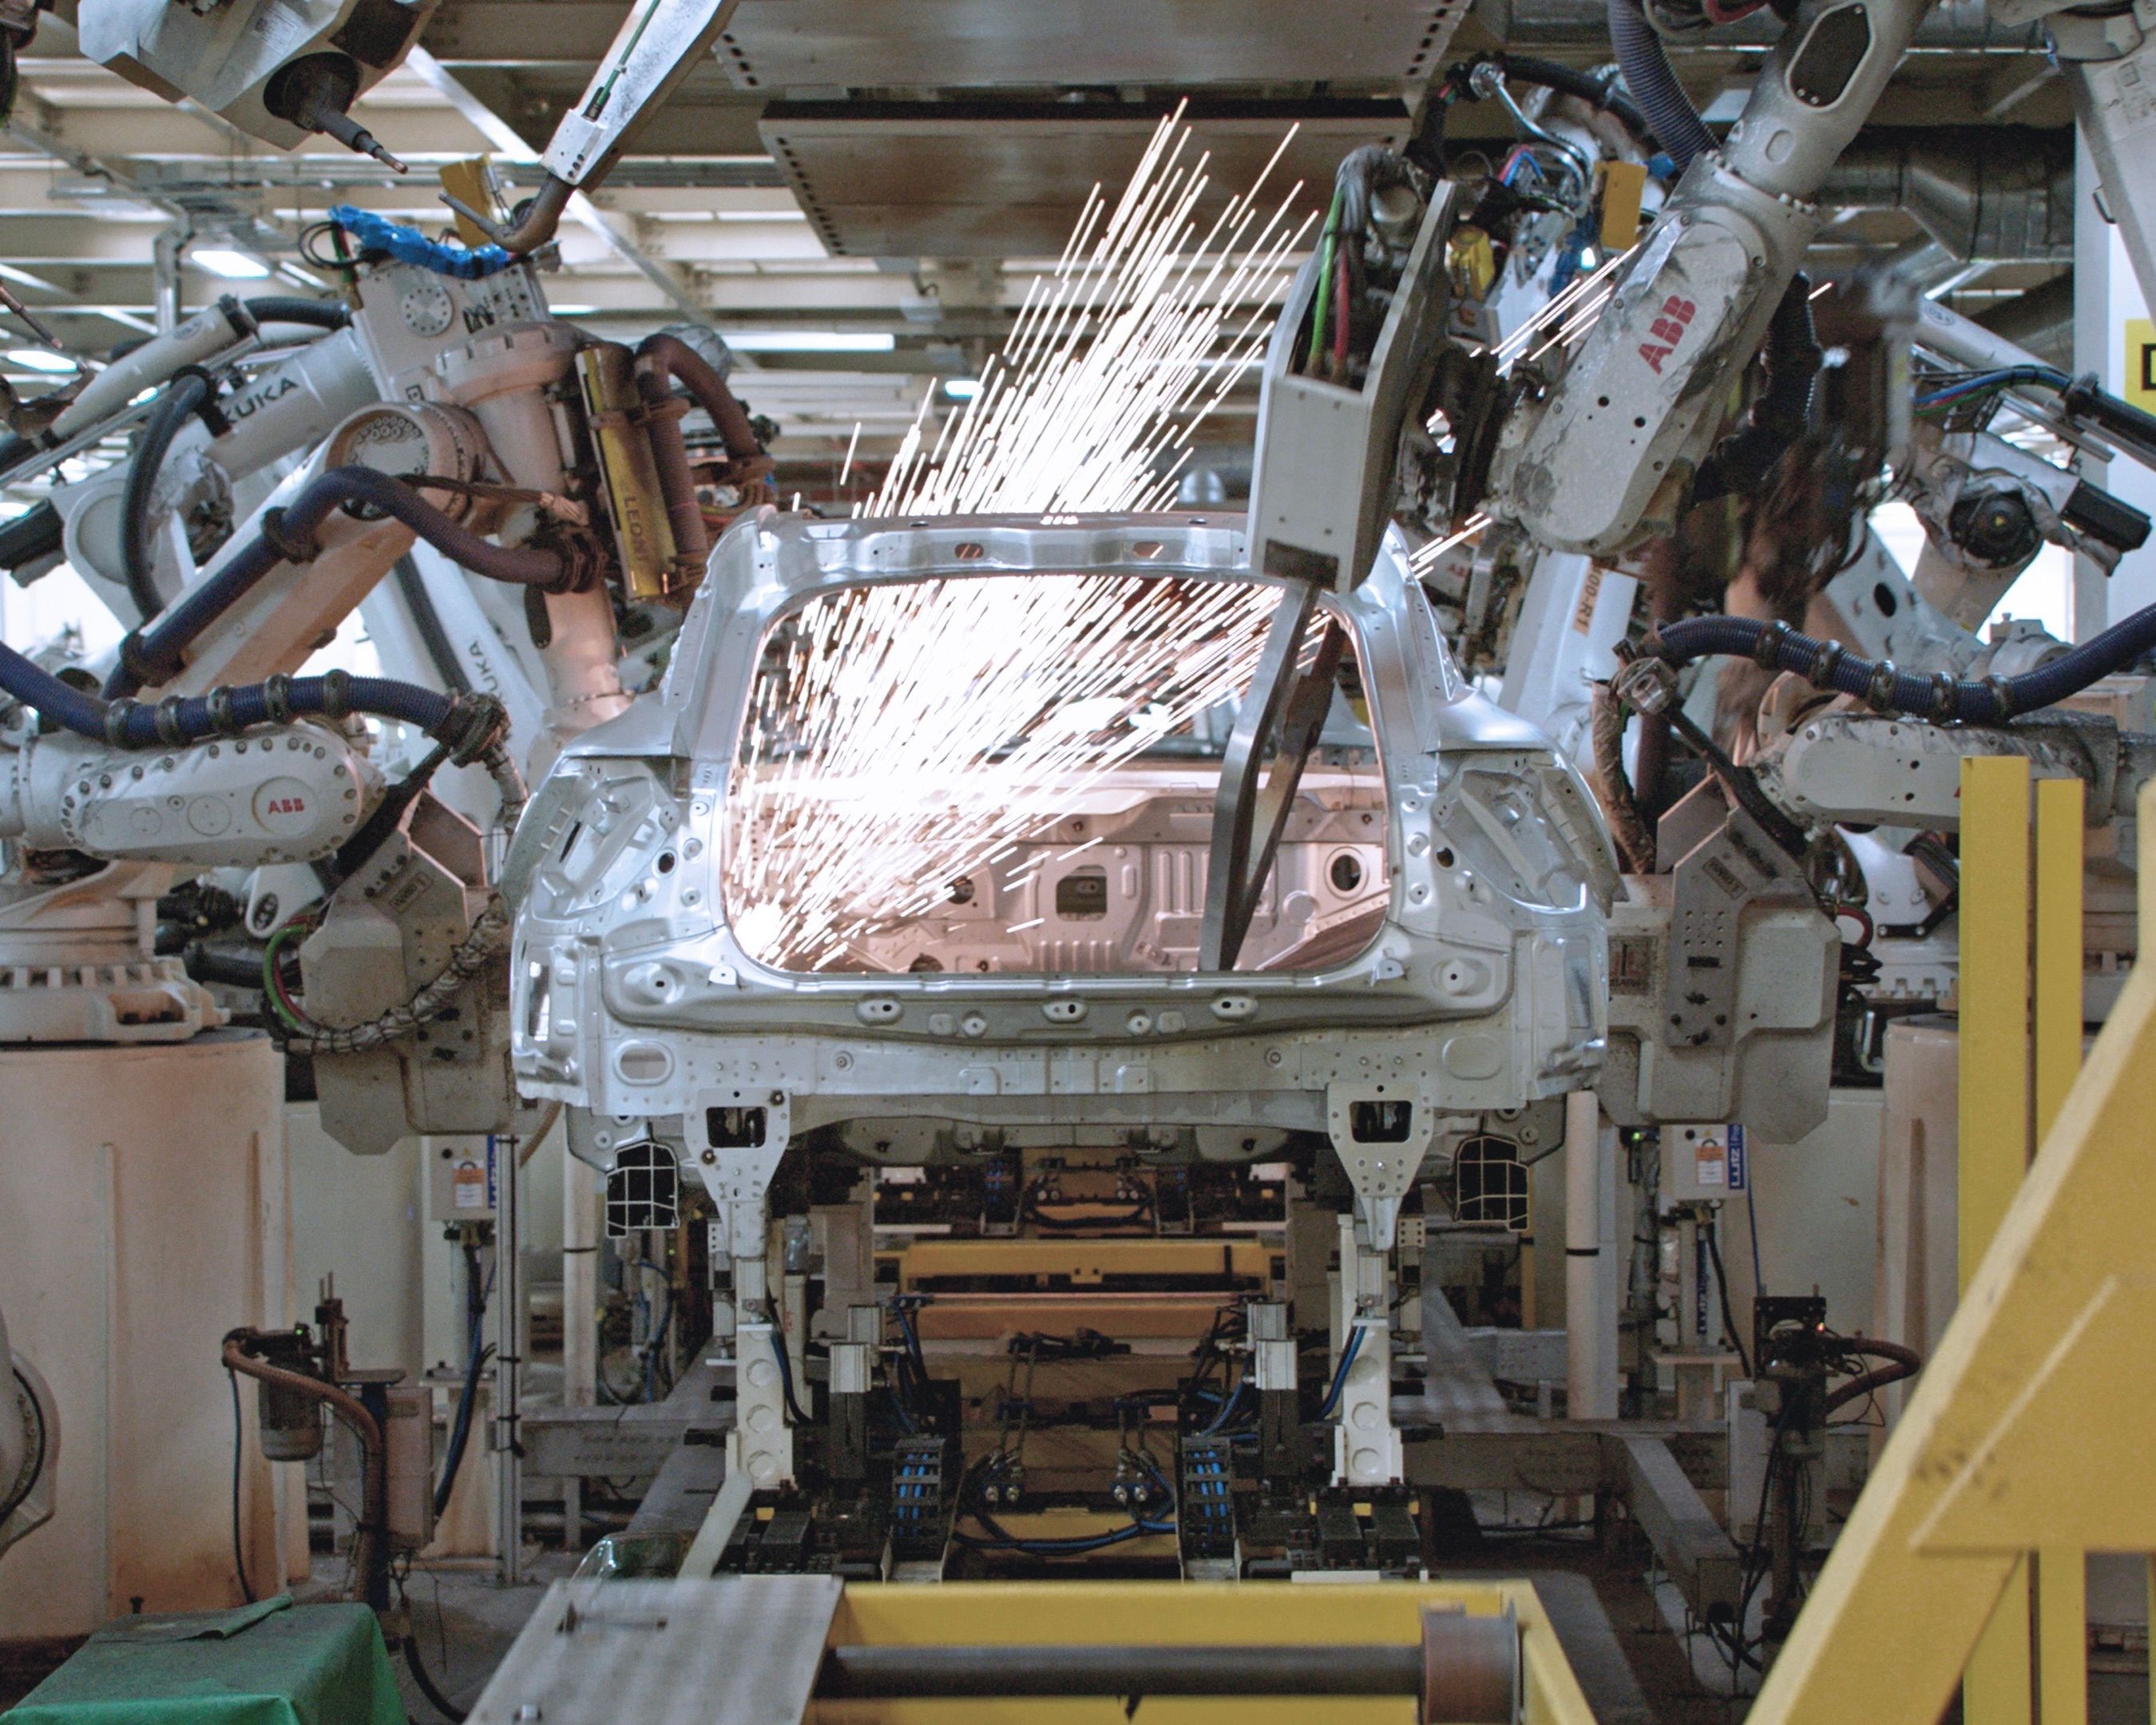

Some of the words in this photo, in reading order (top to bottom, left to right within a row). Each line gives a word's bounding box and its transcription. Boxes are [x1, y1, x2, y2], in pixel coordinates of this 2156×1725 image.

[1638, 295, 1696, 376] ABB
[469, 640, 504, 700] UKA
[268, 797, 305, 815] ABB
